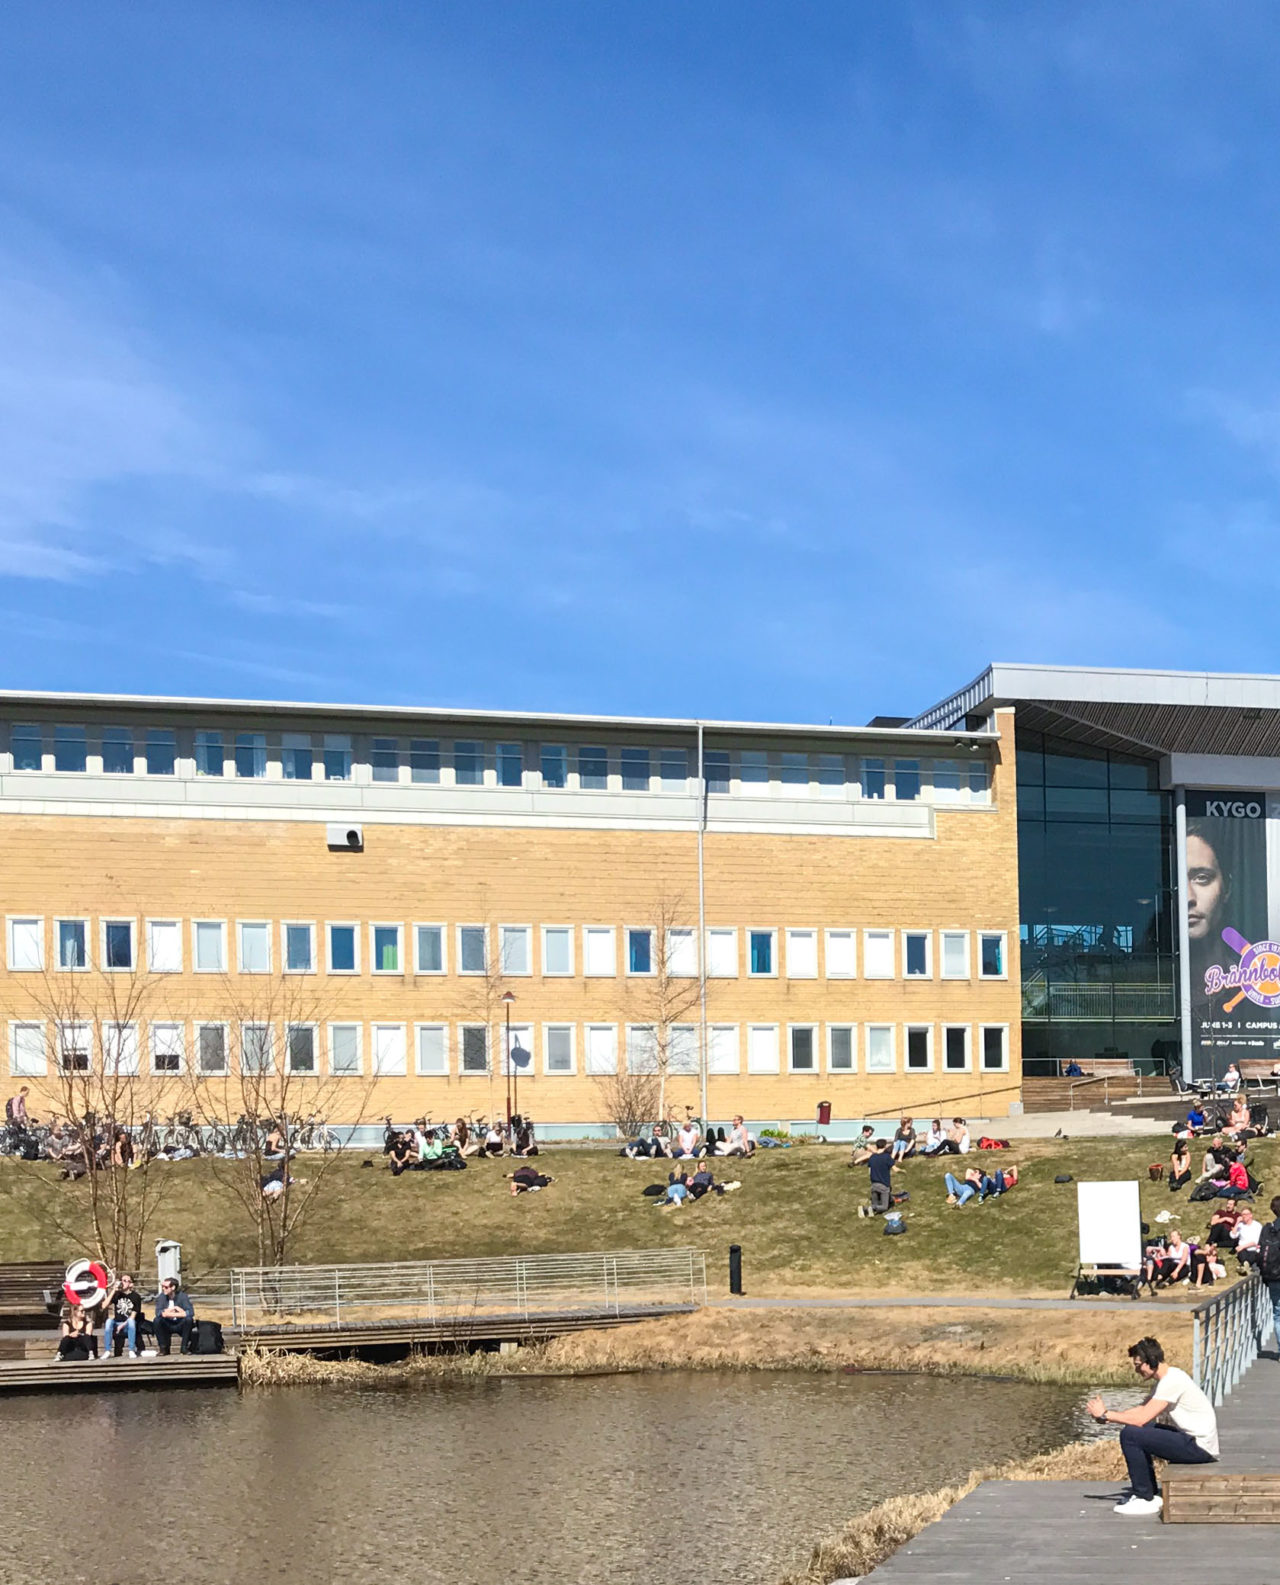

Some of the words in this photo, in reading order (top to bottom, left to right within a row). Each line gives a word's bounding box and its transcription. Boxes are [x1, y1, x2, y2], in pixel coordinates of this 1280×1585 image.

[1206, 801, 1262, 818] KYGO
[1253, 943, 1271, 954] SINCE
[1221, 1021, 1233, 1029] 1-3
[1245, 1021, 1278, 1030] CAMPUS
